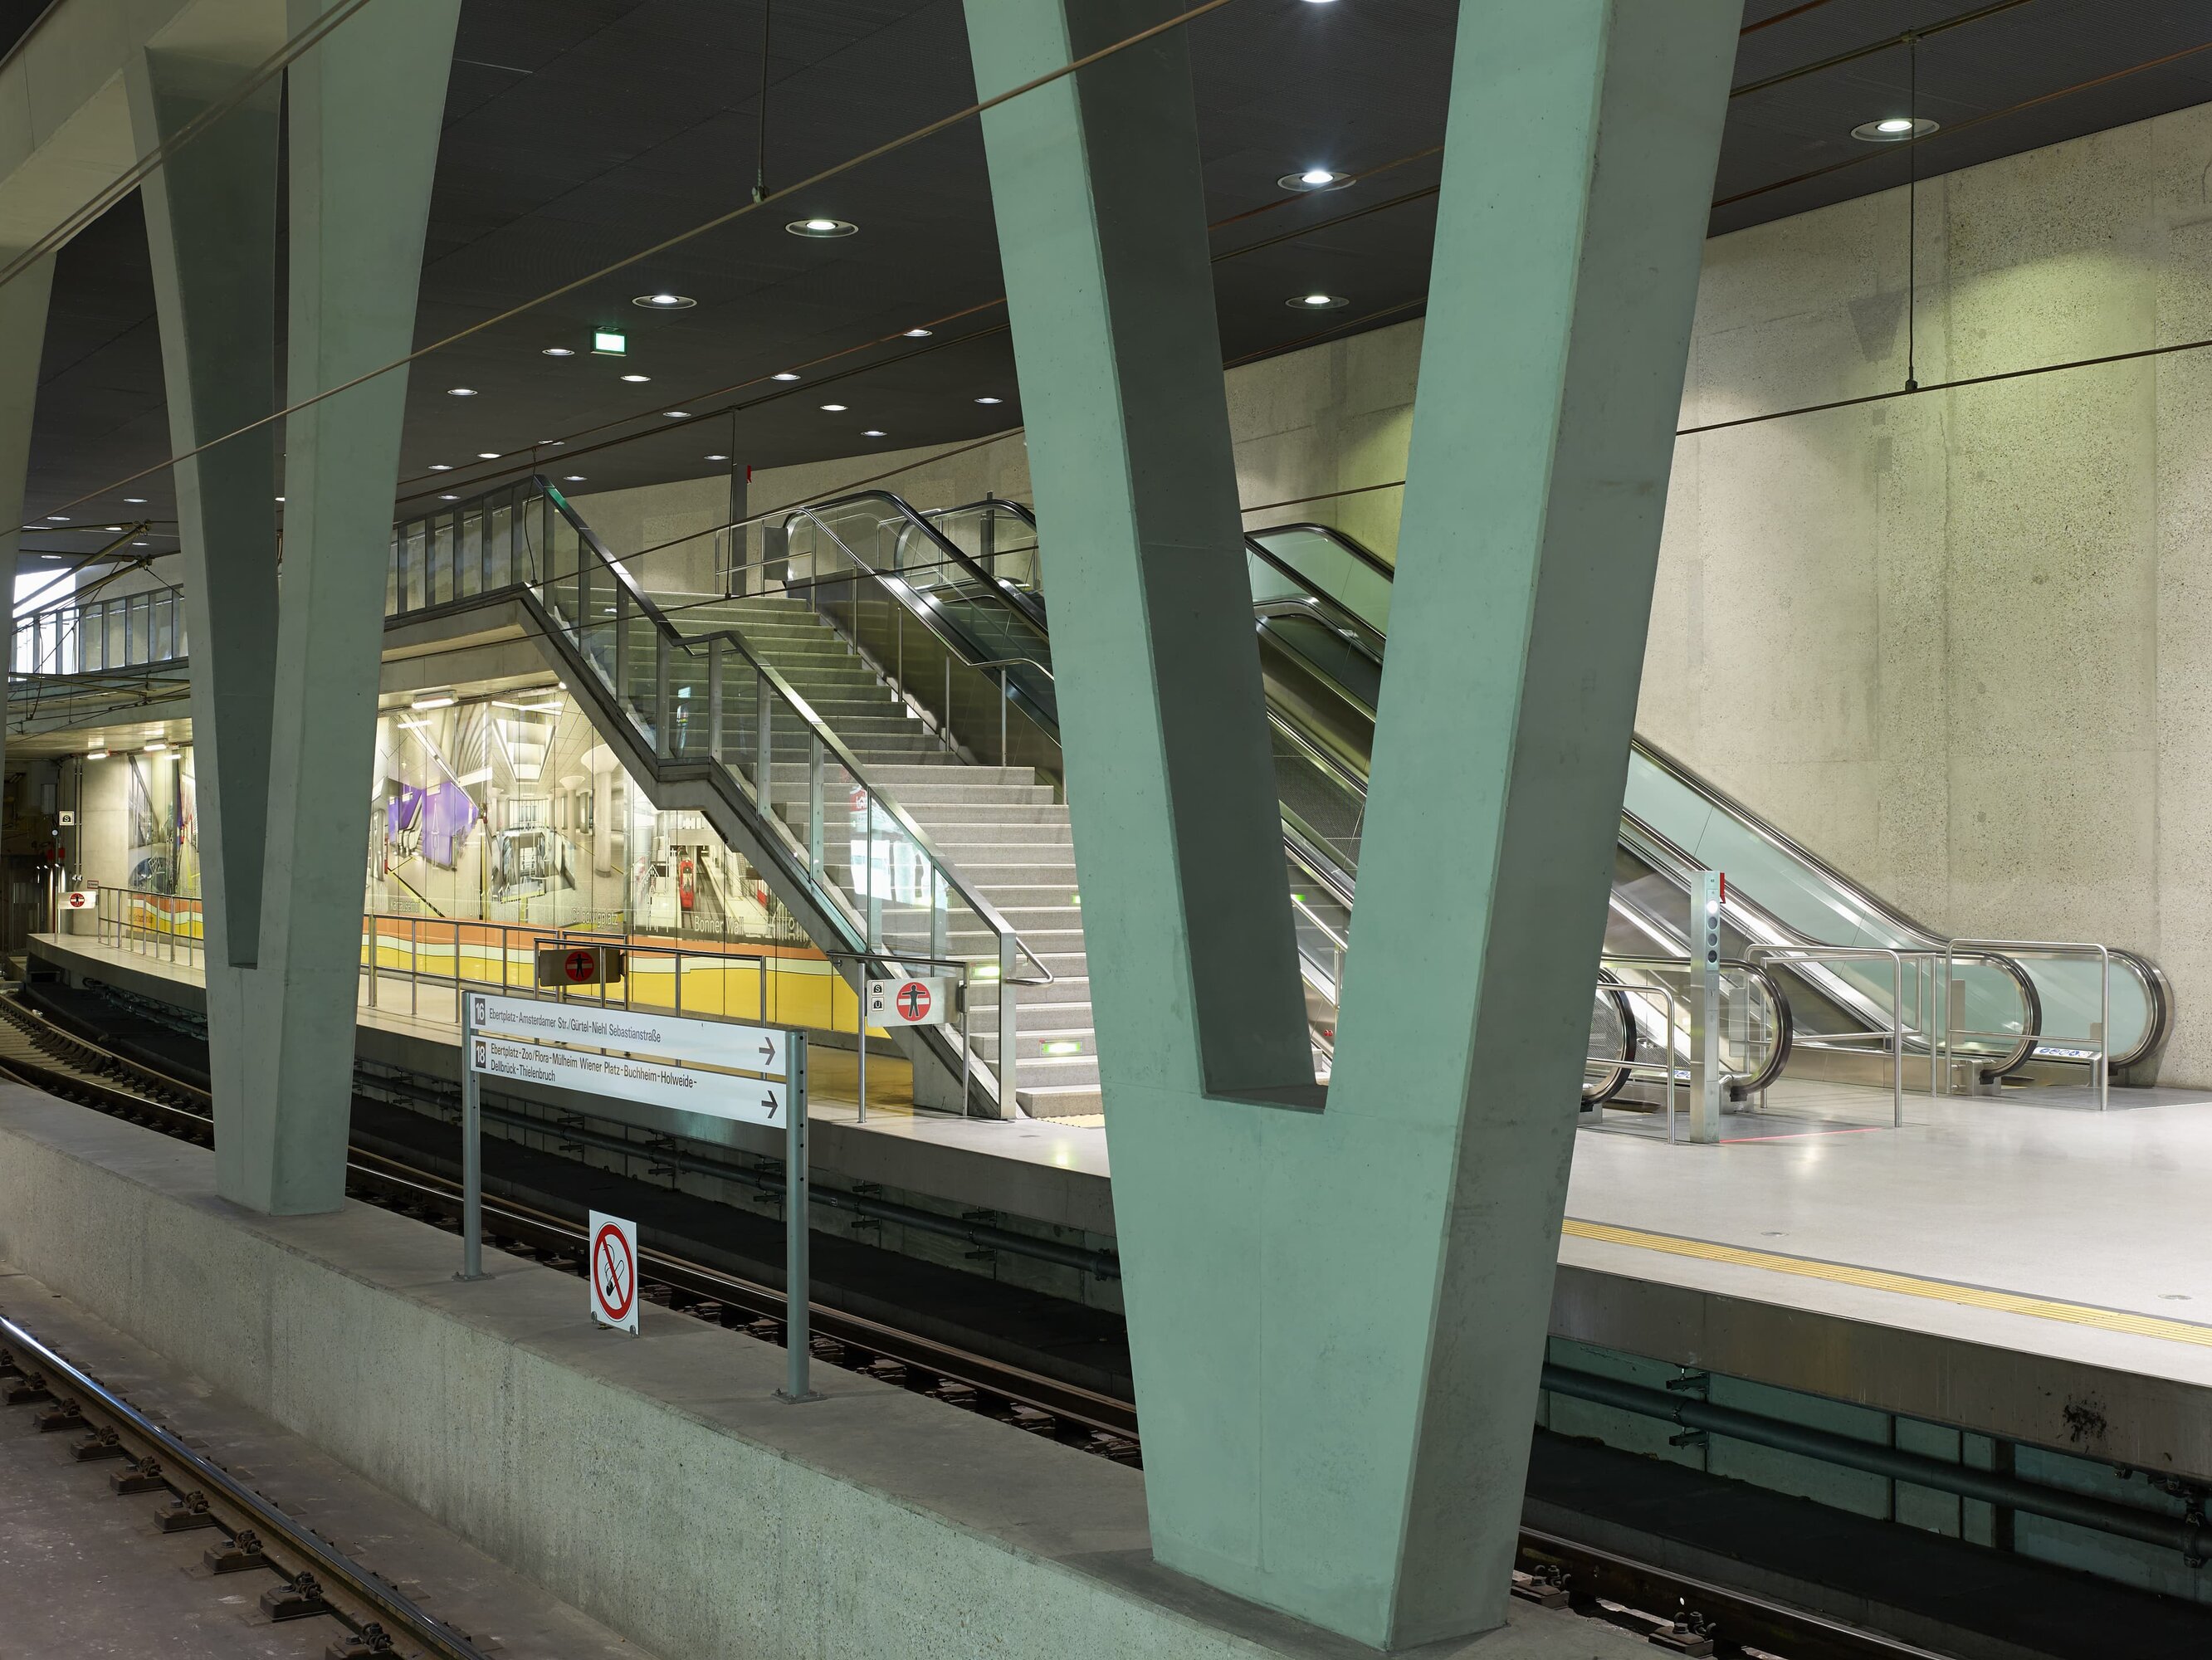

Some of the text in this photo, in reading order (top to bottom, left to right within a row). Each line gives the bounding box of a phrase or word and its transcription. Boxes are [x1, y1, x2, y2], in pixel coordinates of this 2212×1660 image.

[694, 915, 745, 935] Bonner Wall
[476, 1003, 485, 1021] 16
[489, 1008, 662, 1043] Ebertplatz-Amsterdamer Str./Gürtel-Niehl Sebastianstraße
[476, 1046, 486, 1064] 18
[491, 1042, 697, 1089] Ebertplatz-Zoo/Flora-Mülheim Wiener Platz-Buchheim-Holweide-
[491, 1059, 556, 1082] Dellbrück-Thielenbruch
